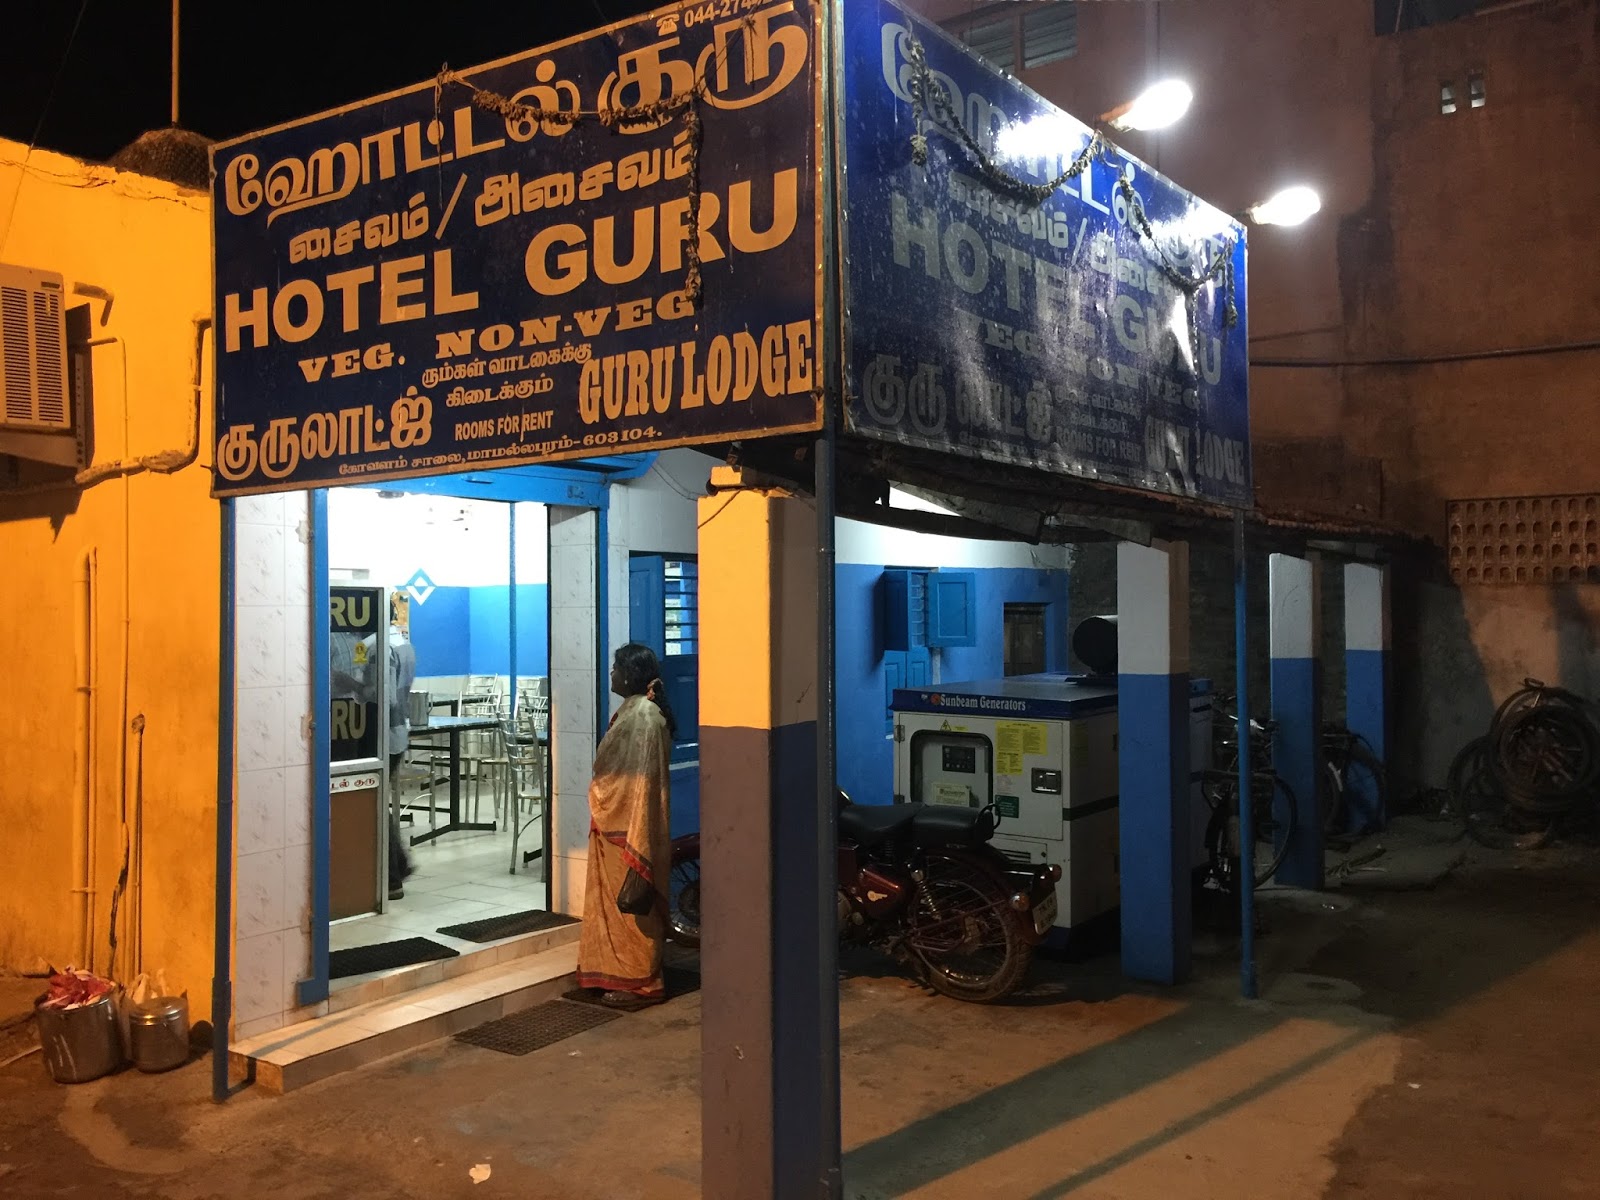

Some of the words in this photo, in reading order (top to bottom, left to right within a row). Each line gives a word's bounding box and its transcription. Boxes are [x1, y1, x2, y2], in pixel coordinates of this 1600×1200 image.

[225, 60, 581, 230] ஹோட்டல்
[597, 1, 808, 136] குரு
[225, 248, 479, 353] HOTEL
[525, 168, 798, 296] GURU
[298, 342, 406, 383] VEG.
[579, 345, 676, 425] GURU
[680, 320, 813, 410] LODGE
[455, 419, 495, 441] ROOMS
[497, 415, 520, 435] FOR
[522, 410, 554, 431] RENT
[940, 693, 978, 709] Sunbeam
[979, 696, 1026, 712] Generators
